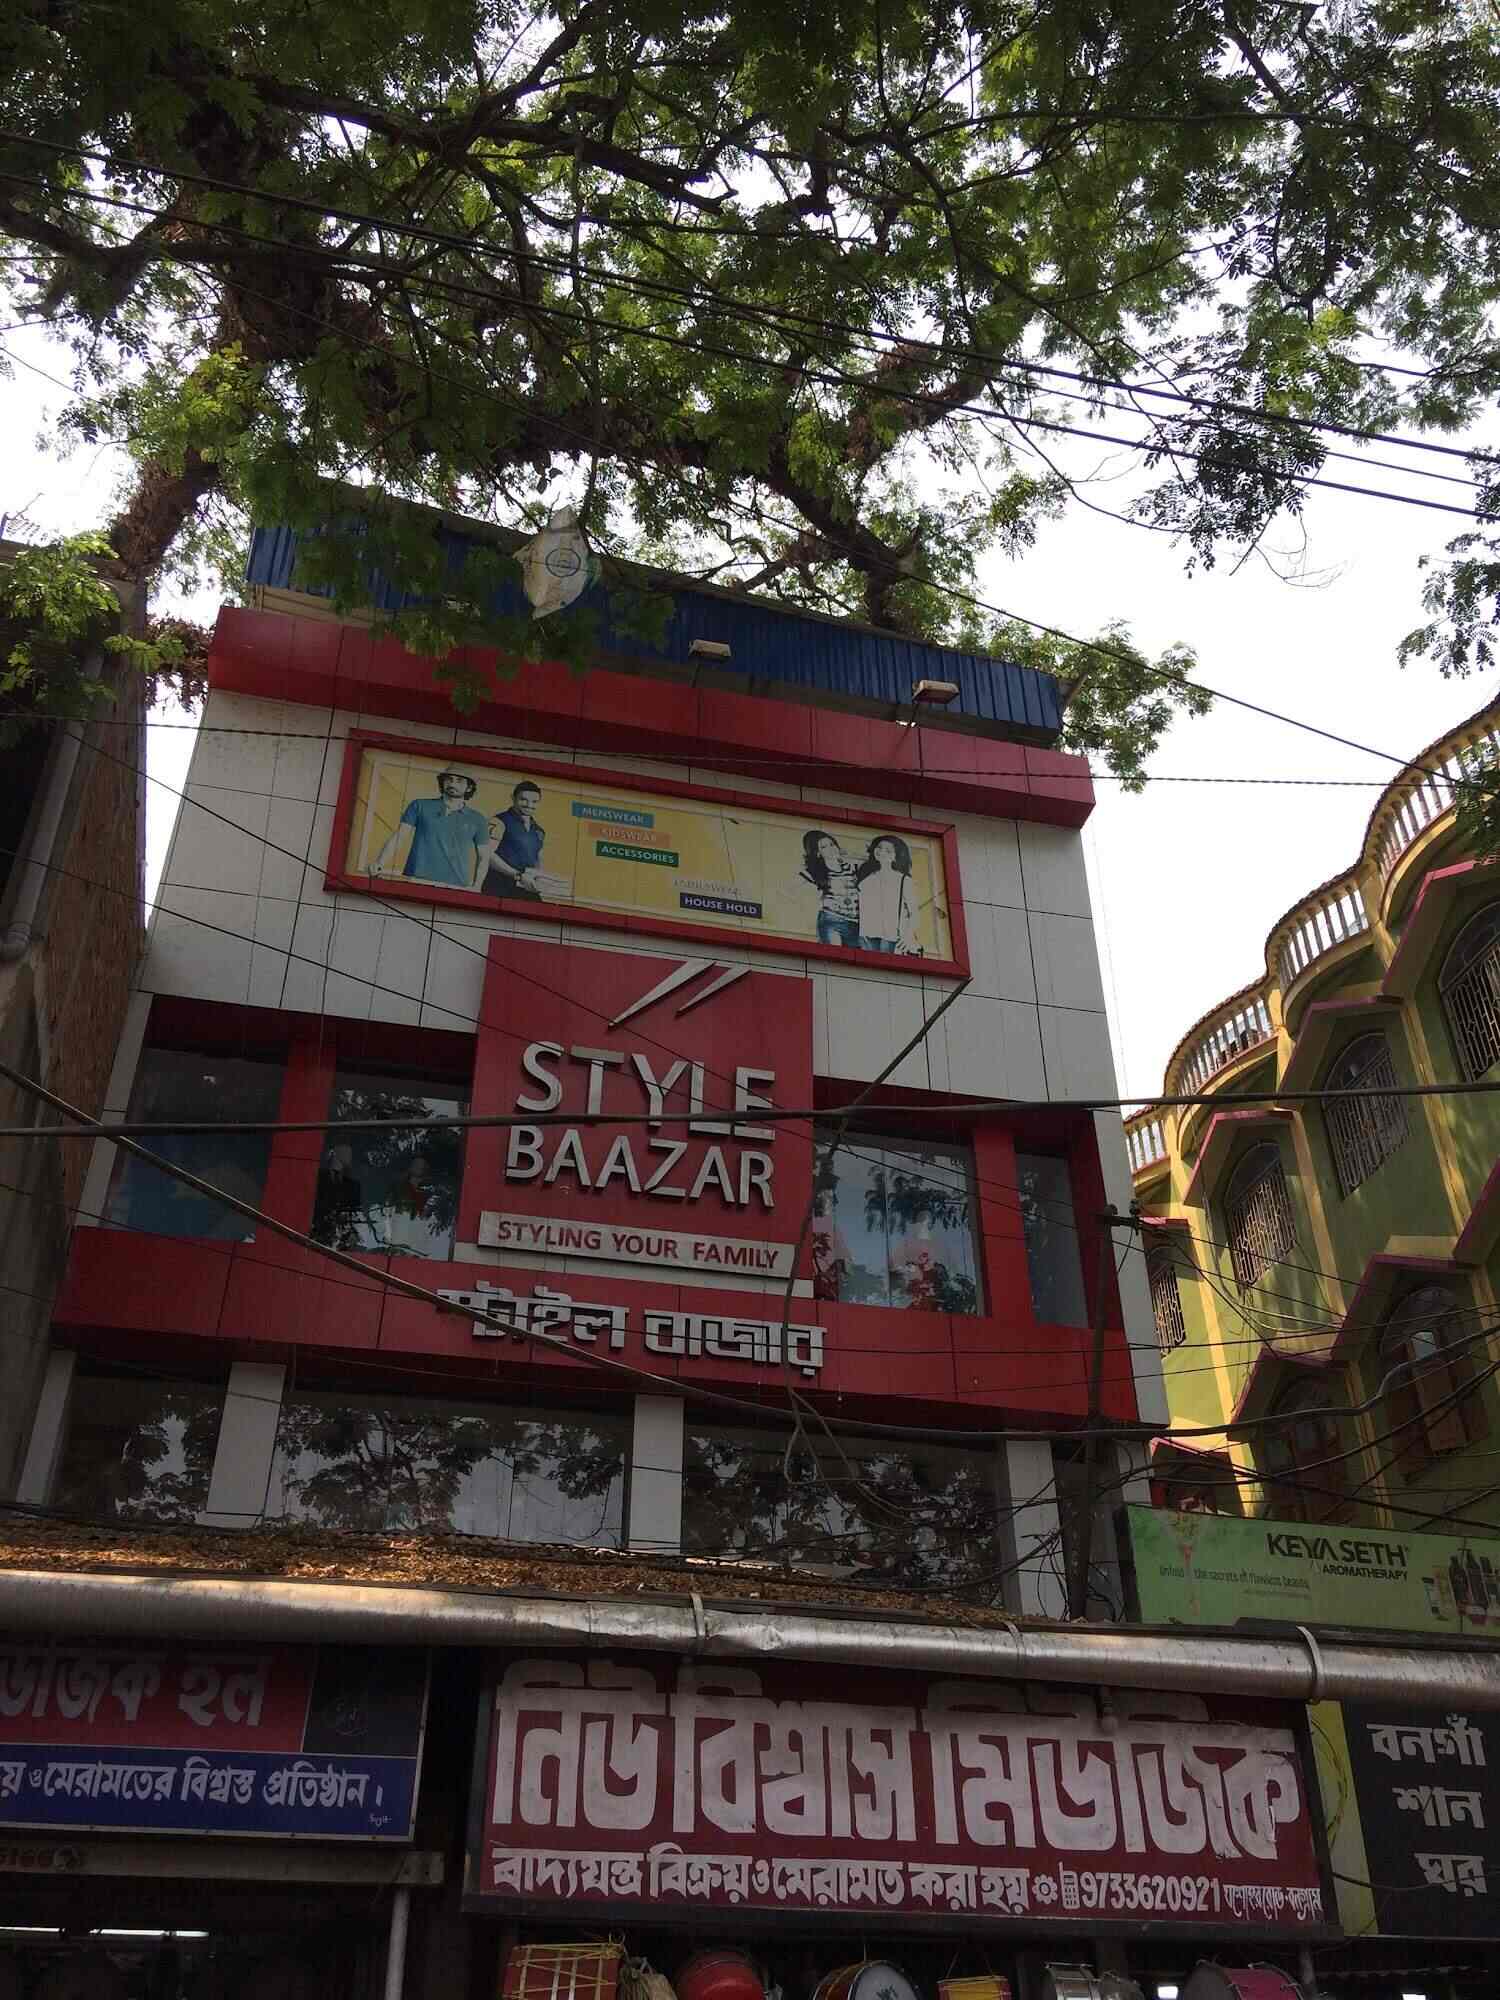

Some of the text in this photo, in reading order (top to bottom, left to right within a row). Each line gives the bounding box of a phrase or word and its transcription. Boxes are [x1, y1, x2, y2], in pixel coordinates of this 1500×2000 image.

[580, 806, 645, 826] MENSWEAR
[600, 845, 676, 864] ACCESSORIES
[684, 895, 758, 915] HOUSE HOLD
[515, 1040, 776, 1142] STYLE
[504, 1123, 776, 1209] BAAZAR
[498, 1220, 779, 1270] STYLING YOUR FAMILY
[644, 1308, 828, 1377] বাজার
[1266, 1532, 1406, 1567] KEYA SETH
[1323, 1564, 1407, 1581] AROMATHERAPY
[43, 1759, 179, 1801] মেরামতের
[181, 1755, 257, 1805] বিশ্বস্ত
[491, 1660, 1300, 1860] নিউ বিশ্বাস মিউজিক
[907, 1863, 977, 1911] করা
[979, 1866, 1031, 1915] হয়
[1079, 1871, 1221, 1913] 9733620921
